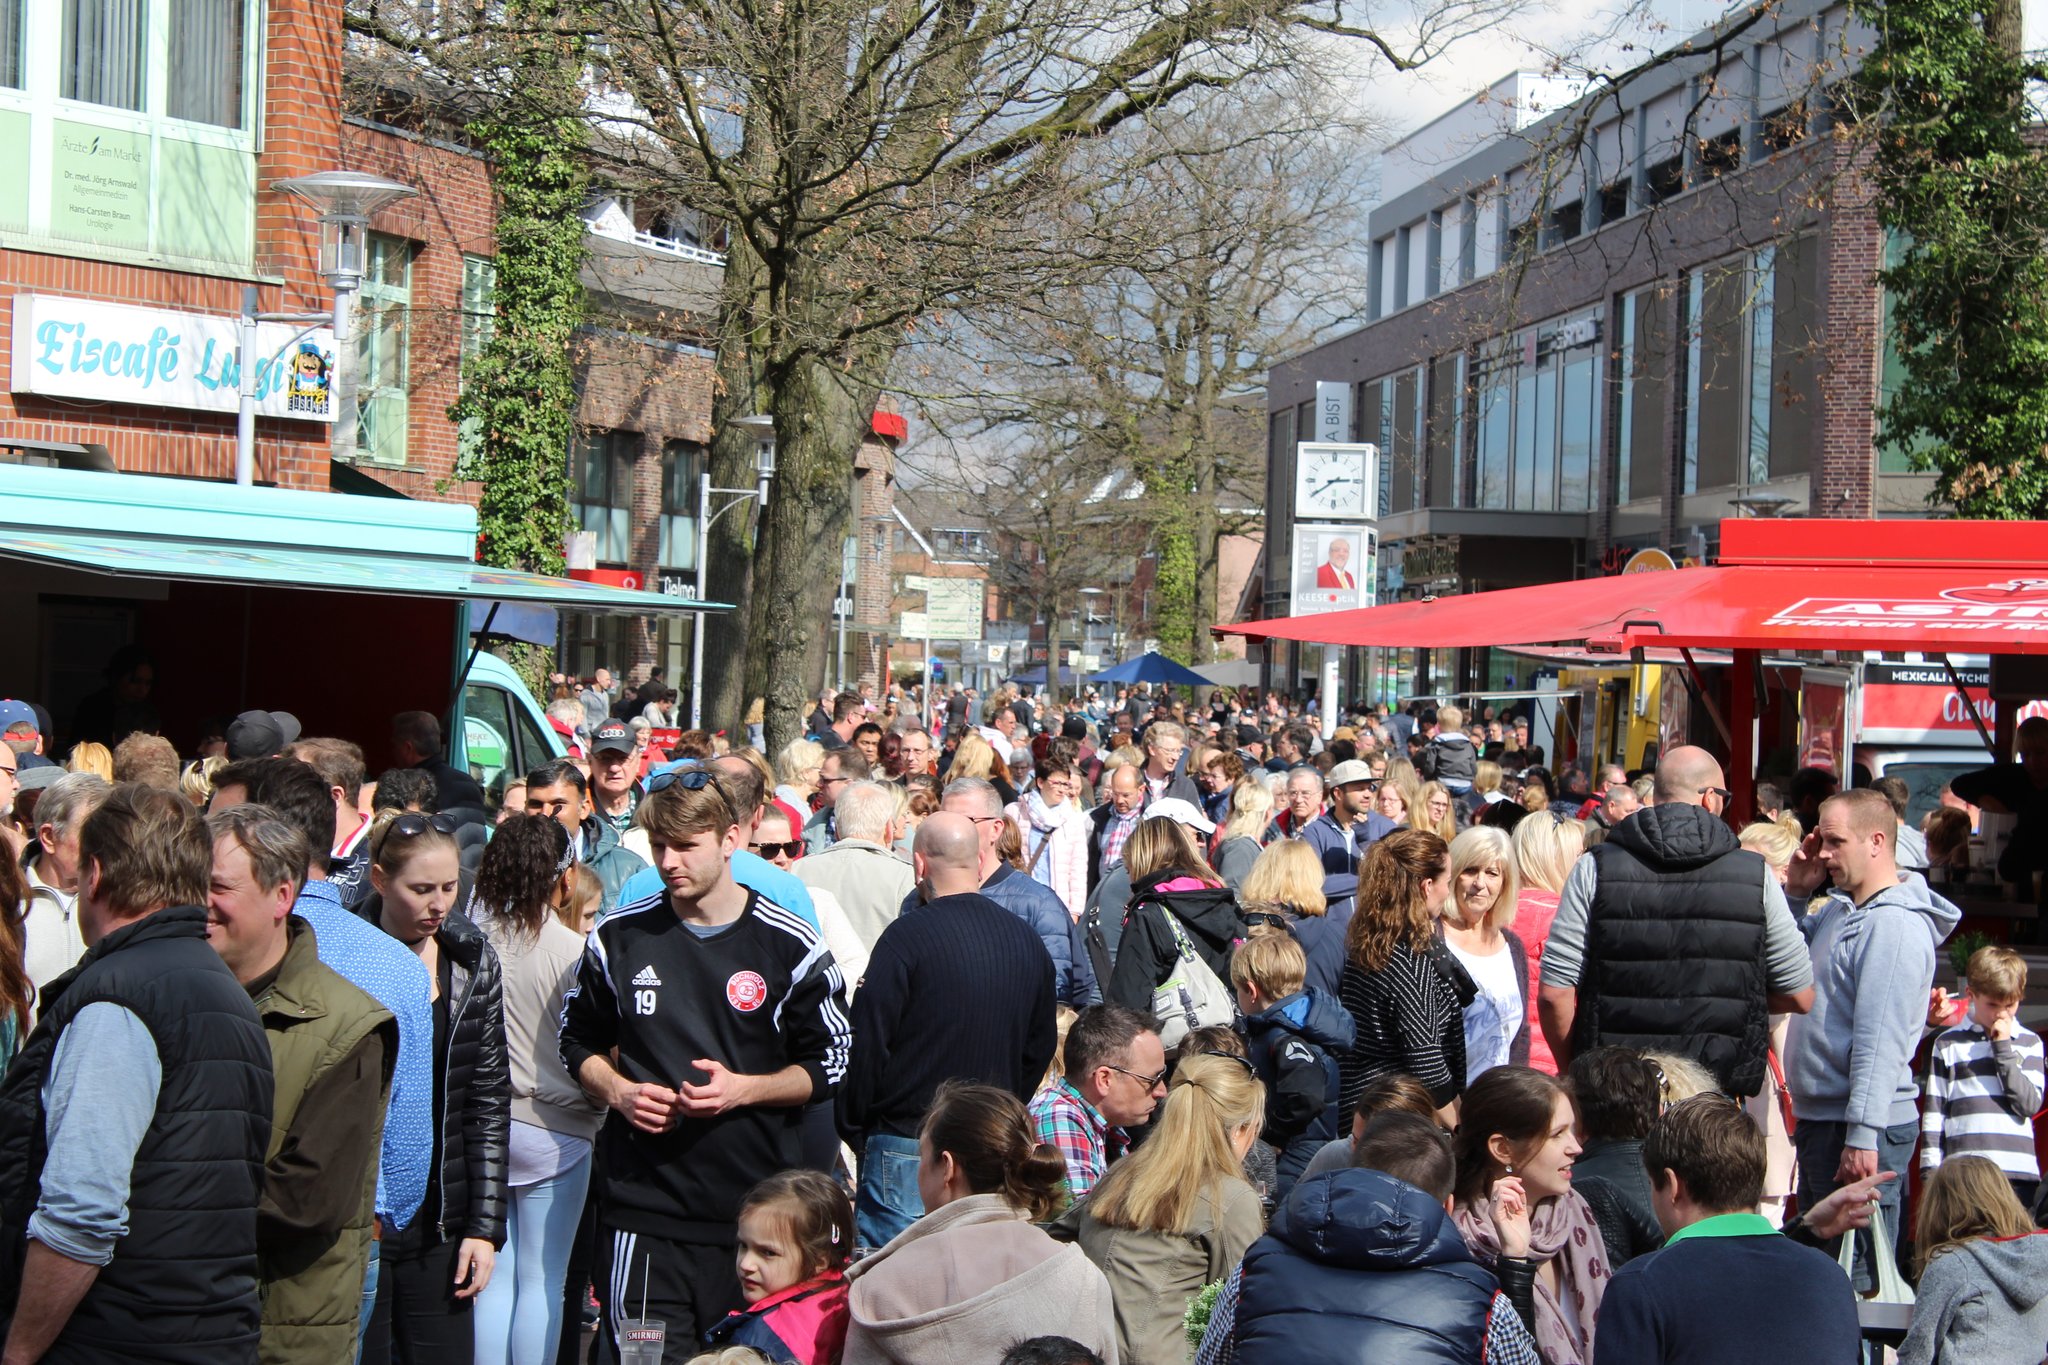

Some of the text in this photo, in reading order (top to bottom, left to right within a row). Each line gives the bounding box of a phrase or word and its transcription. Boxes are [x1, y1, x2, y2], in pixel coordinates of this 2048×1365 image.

[62, 136, 142, 163] Ärzte am Markt
[64, 170, 137, 189] Dr. med. Jörg Arnswald
[73, 184, 128, 200] Allgemeinmedizin
[69, 203, 131, 220] Hans-Carsten Braun
[86, 218, 113, 231] Urologie
[36, 320, 284, 401] Eiscafé Lugi
[1325, 397, 1340, 425] BIST
[1298, 592, 1329, 602] KEESE
[1760, 618, 1917, 628] Trinken
[1892, 671, 1989, 683] MEXICALI TCHE
[632, 978, 661, 986] adidas
[730, 972, 765, 990] BUCHHOLZ
[634, 990, 656, 1015] 19
[627, 1331, 662, 1340] SMIRNOFF
